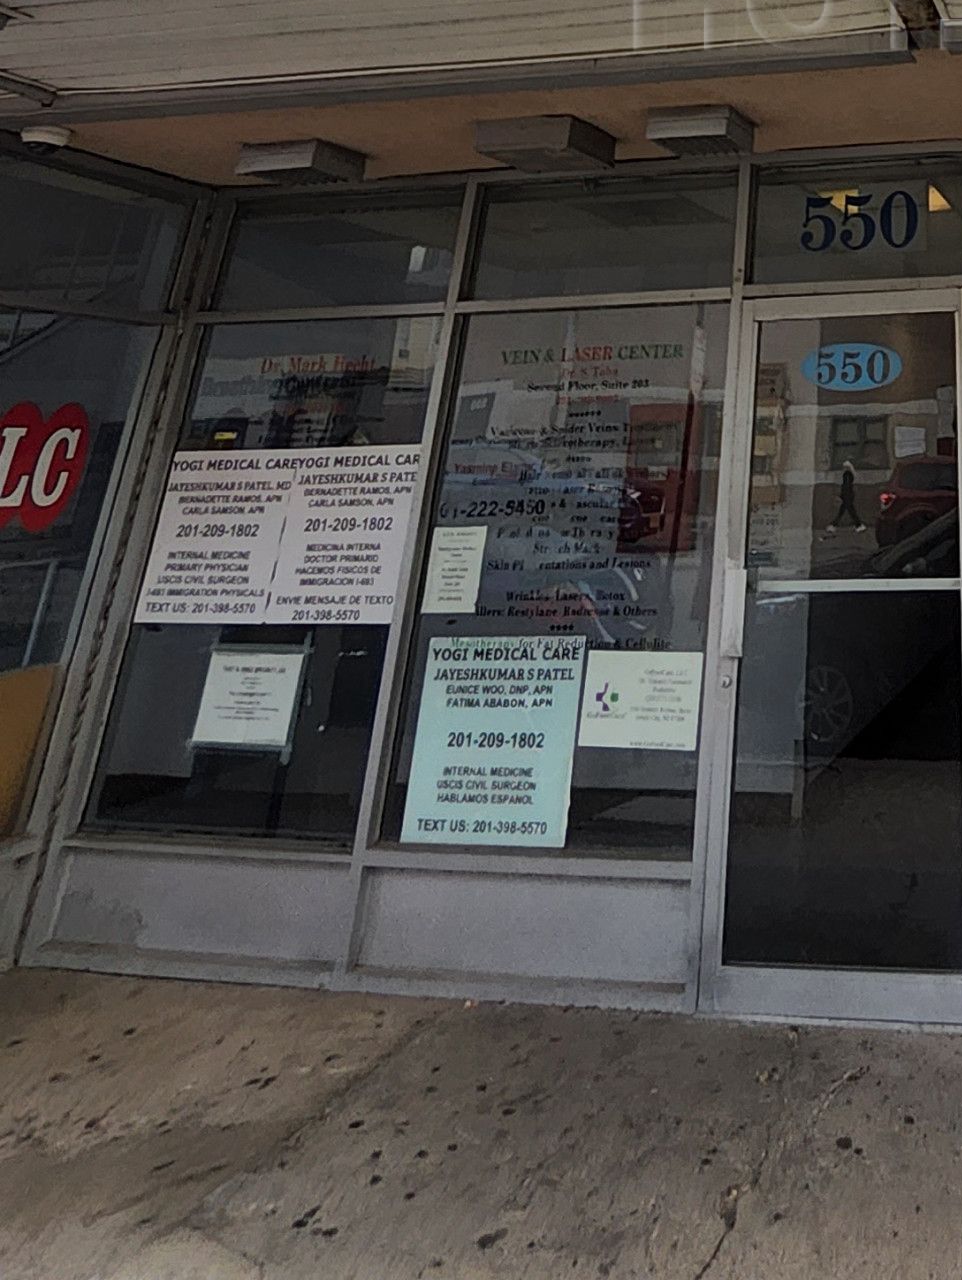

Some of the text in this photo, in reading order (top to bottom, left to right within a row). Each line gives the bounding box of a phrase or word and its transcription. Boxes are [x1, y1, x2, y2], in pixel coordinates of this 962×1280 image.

[801, 190, 919, 252] 550
[501, 349, 540, 365] VEIN
[560, 346, 613, 362] LASER
[617, 344, 685, 361] CENTER
[816, 348, 892, 385] 550
[601, 379, 630, 390] Suite
[173, 457, 297, 471] YOGI MEDICAL CARE
[297, 456, 330, 469] YOGI
[333, 455, 391, 468] MEDICAL
[298, 472, 379, 486] JAYESHKUMAR
[380, 472, 388, 482] S
[168, 481, 236, 492] JAYESHKUMAR
[275, 480, 292, 491] MD
[303, 487, 358, 497] BERNADETTE
[178, 494, 231, 505] BERNADETTE
[308, 498, 336, 508] CARLA
[182, 506, 209, 516] CARLA
[303, 517, 393, 532] 201-209-1802
[175, 523, 261, 539] 201-209-1802
[306, 543, 381, 552] MEDICINA INTERNA
[167, 550, 252, 560] INTERNAL MEDICINE
[304, 554, 380, 564] DOCTOR PRIMARIO
[164, 563, 249, 573] PRIMARY PHYSICIAN
[294, 565, 335, 575] HACEMOS
[370, 565, 382, 574] DE
[184, 575, 205, 585] CIVIL
[207, 574, 250, 585] SURGEON
[299, 577, 354, 586] IMMIGRACION
[166, 587, 265, 598] IMMIGRATION PHYSICALS
[276, 595, 394, 605] ENVIE MENSAJE DE TEXTO
[145, 602, 172, 613] TEXT
[191, 602, 257, 615] 201-398-5570
[622, 604, 659, 617] Others
[291, 609, 361, 622] 201-398-5570
[517, 636, 534, 649] for
[432, 646, 581, 662] YOGI MEDICAL CARE
[433, 667, 576, 682] JAYESHKUMAR S PATEL
[445, 684, 480, 695] EUNICE
[533, 684, 554, 695] APN
[446, 697, 553, 709] FATIMA ABABON, APN
[447, 732, 546, 749] 201-209-1802
[442, 766, 534, 778] INTERNAL MEDICINE
[436, 780, 537, 791] USCIS CIVIL SURGEON
[436, 792, 489, 804] HABLAMOS
[416, 817, 548, 835] TEXT US: 201-398-5570
